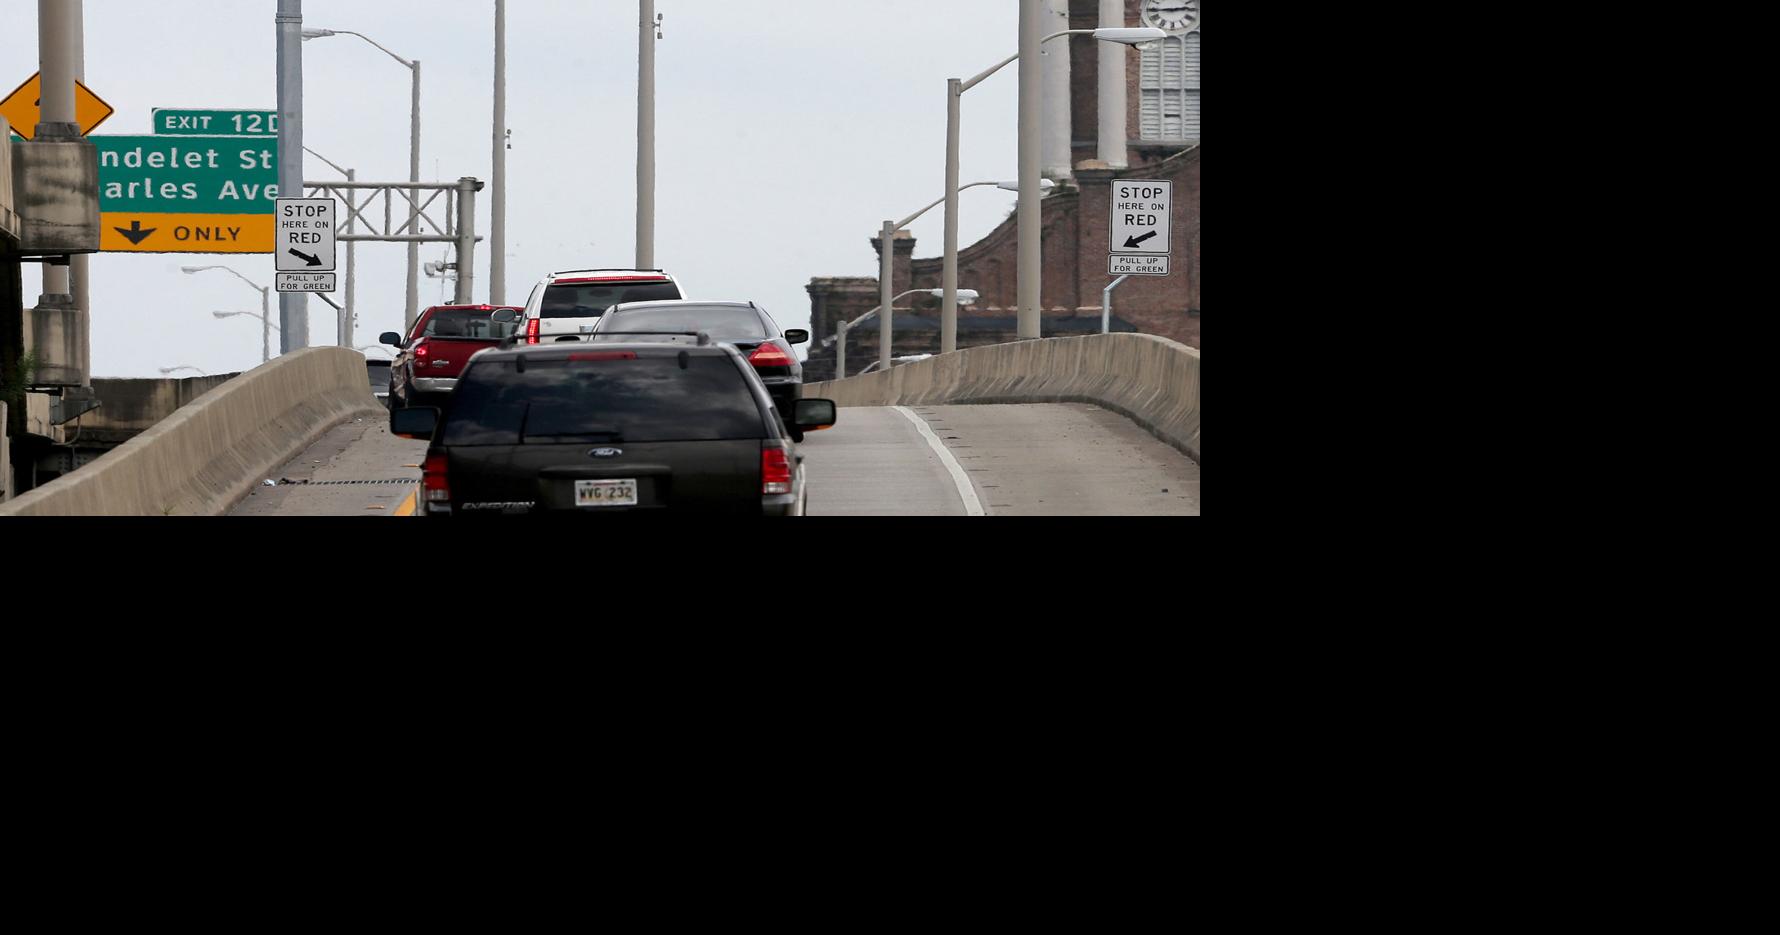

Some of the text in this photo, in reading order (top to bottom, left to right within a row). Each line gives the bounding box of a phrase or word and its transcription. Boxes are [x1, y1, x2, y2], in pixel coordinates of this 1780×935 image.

[165, 116, 212, 129] EXIT
[101, 147, 273, 169] ndelet St
[105, 177, 279, 200] arles Ave
[1120, 187, 1163, 199] STOP
[284, 205, 327, 217] STOP
[1151, 203, 1165, 211] ON
[282, 221, 330, 229] HERE ON
[1124, 214, 1157, 226] RED
[173, 226, 241, 241] ONLY
[289, 233, 322, 244] RED
